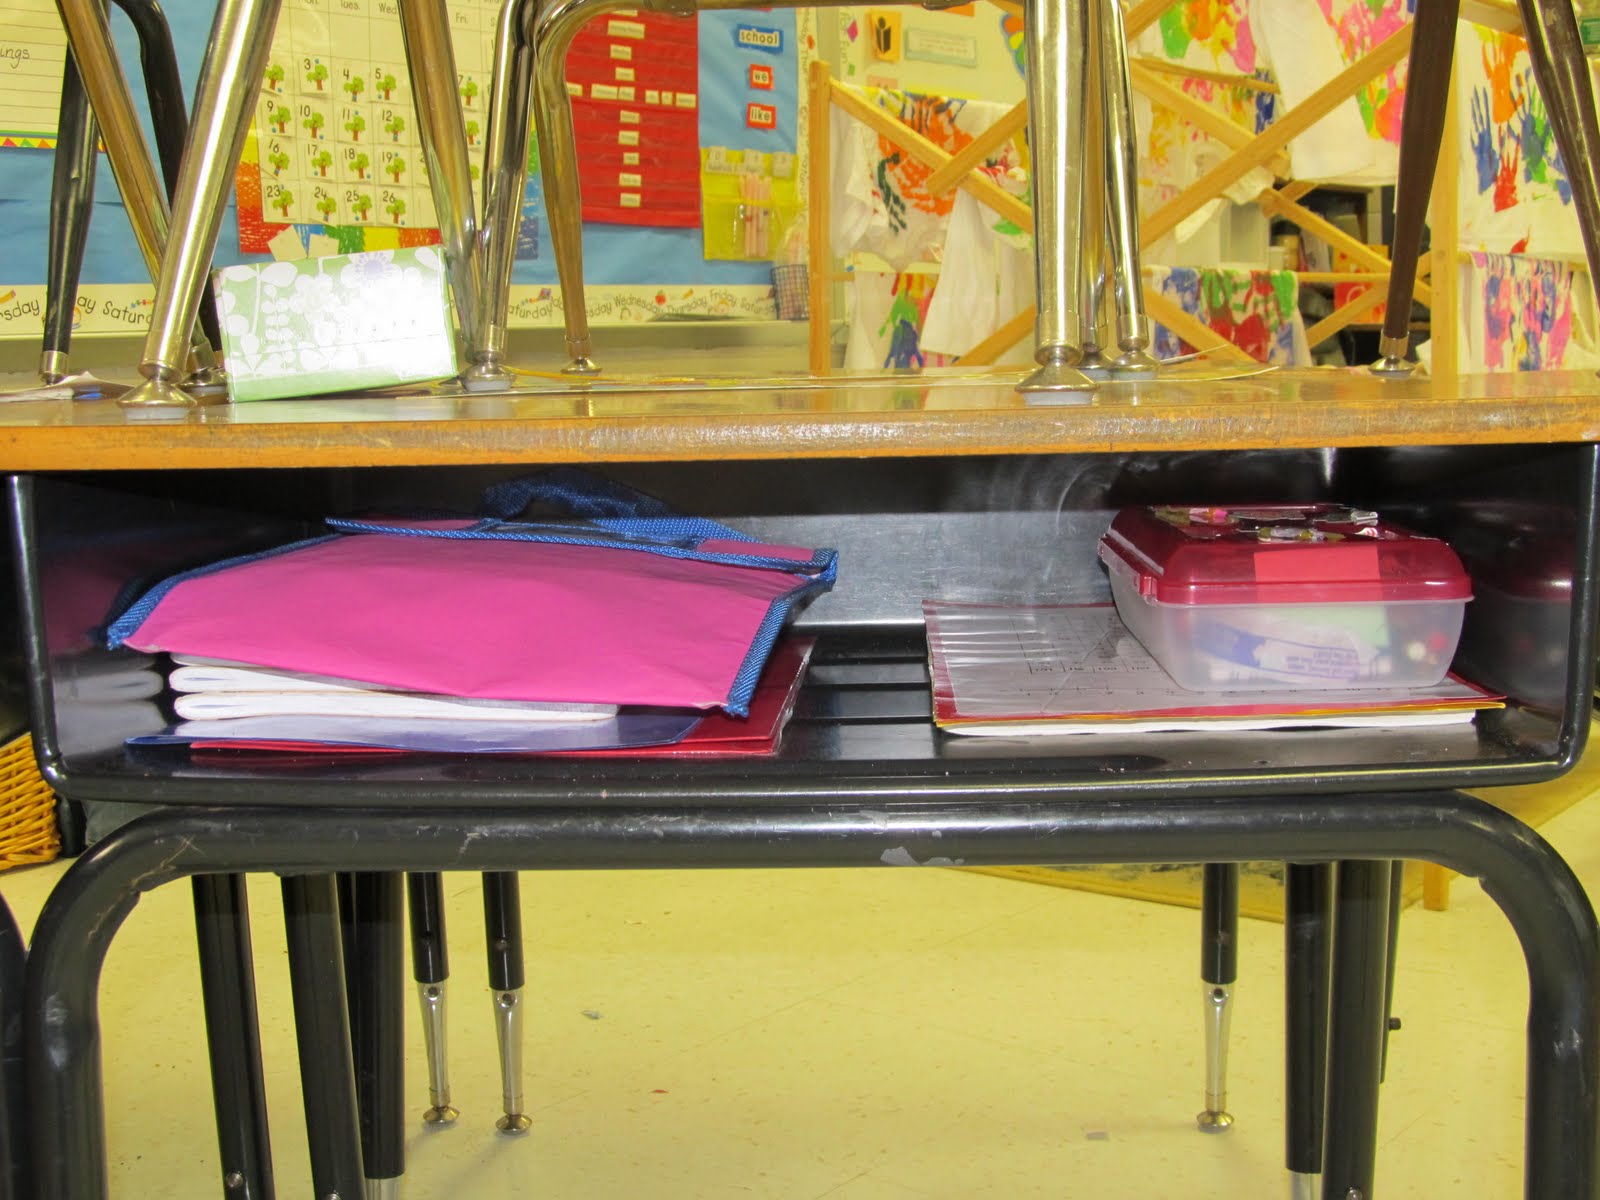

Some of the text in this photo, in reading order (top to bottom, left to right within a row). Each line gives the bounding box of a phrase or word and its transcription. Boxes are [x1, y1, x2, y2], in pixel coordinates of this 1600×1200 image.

[740, 29, 778, 45] school
[303, 58, 312, 71] 3
[343, 67, 350, 81] 4
[375, 68, 382, 80] 5
[754, 72, 769, 82] we
[266, 100, 393, 122] 9 10 11 12
[751, 106, 771, 122] like
[268, 138, 281, 154] 16
[307, 143, 318, 156] 17
[344, 147, 356, 160] 18
[382, 151, 393, 163] 19
[266, 185, 396, 204] 23 24 25 26
[508, 302, 553, 320] aturday
